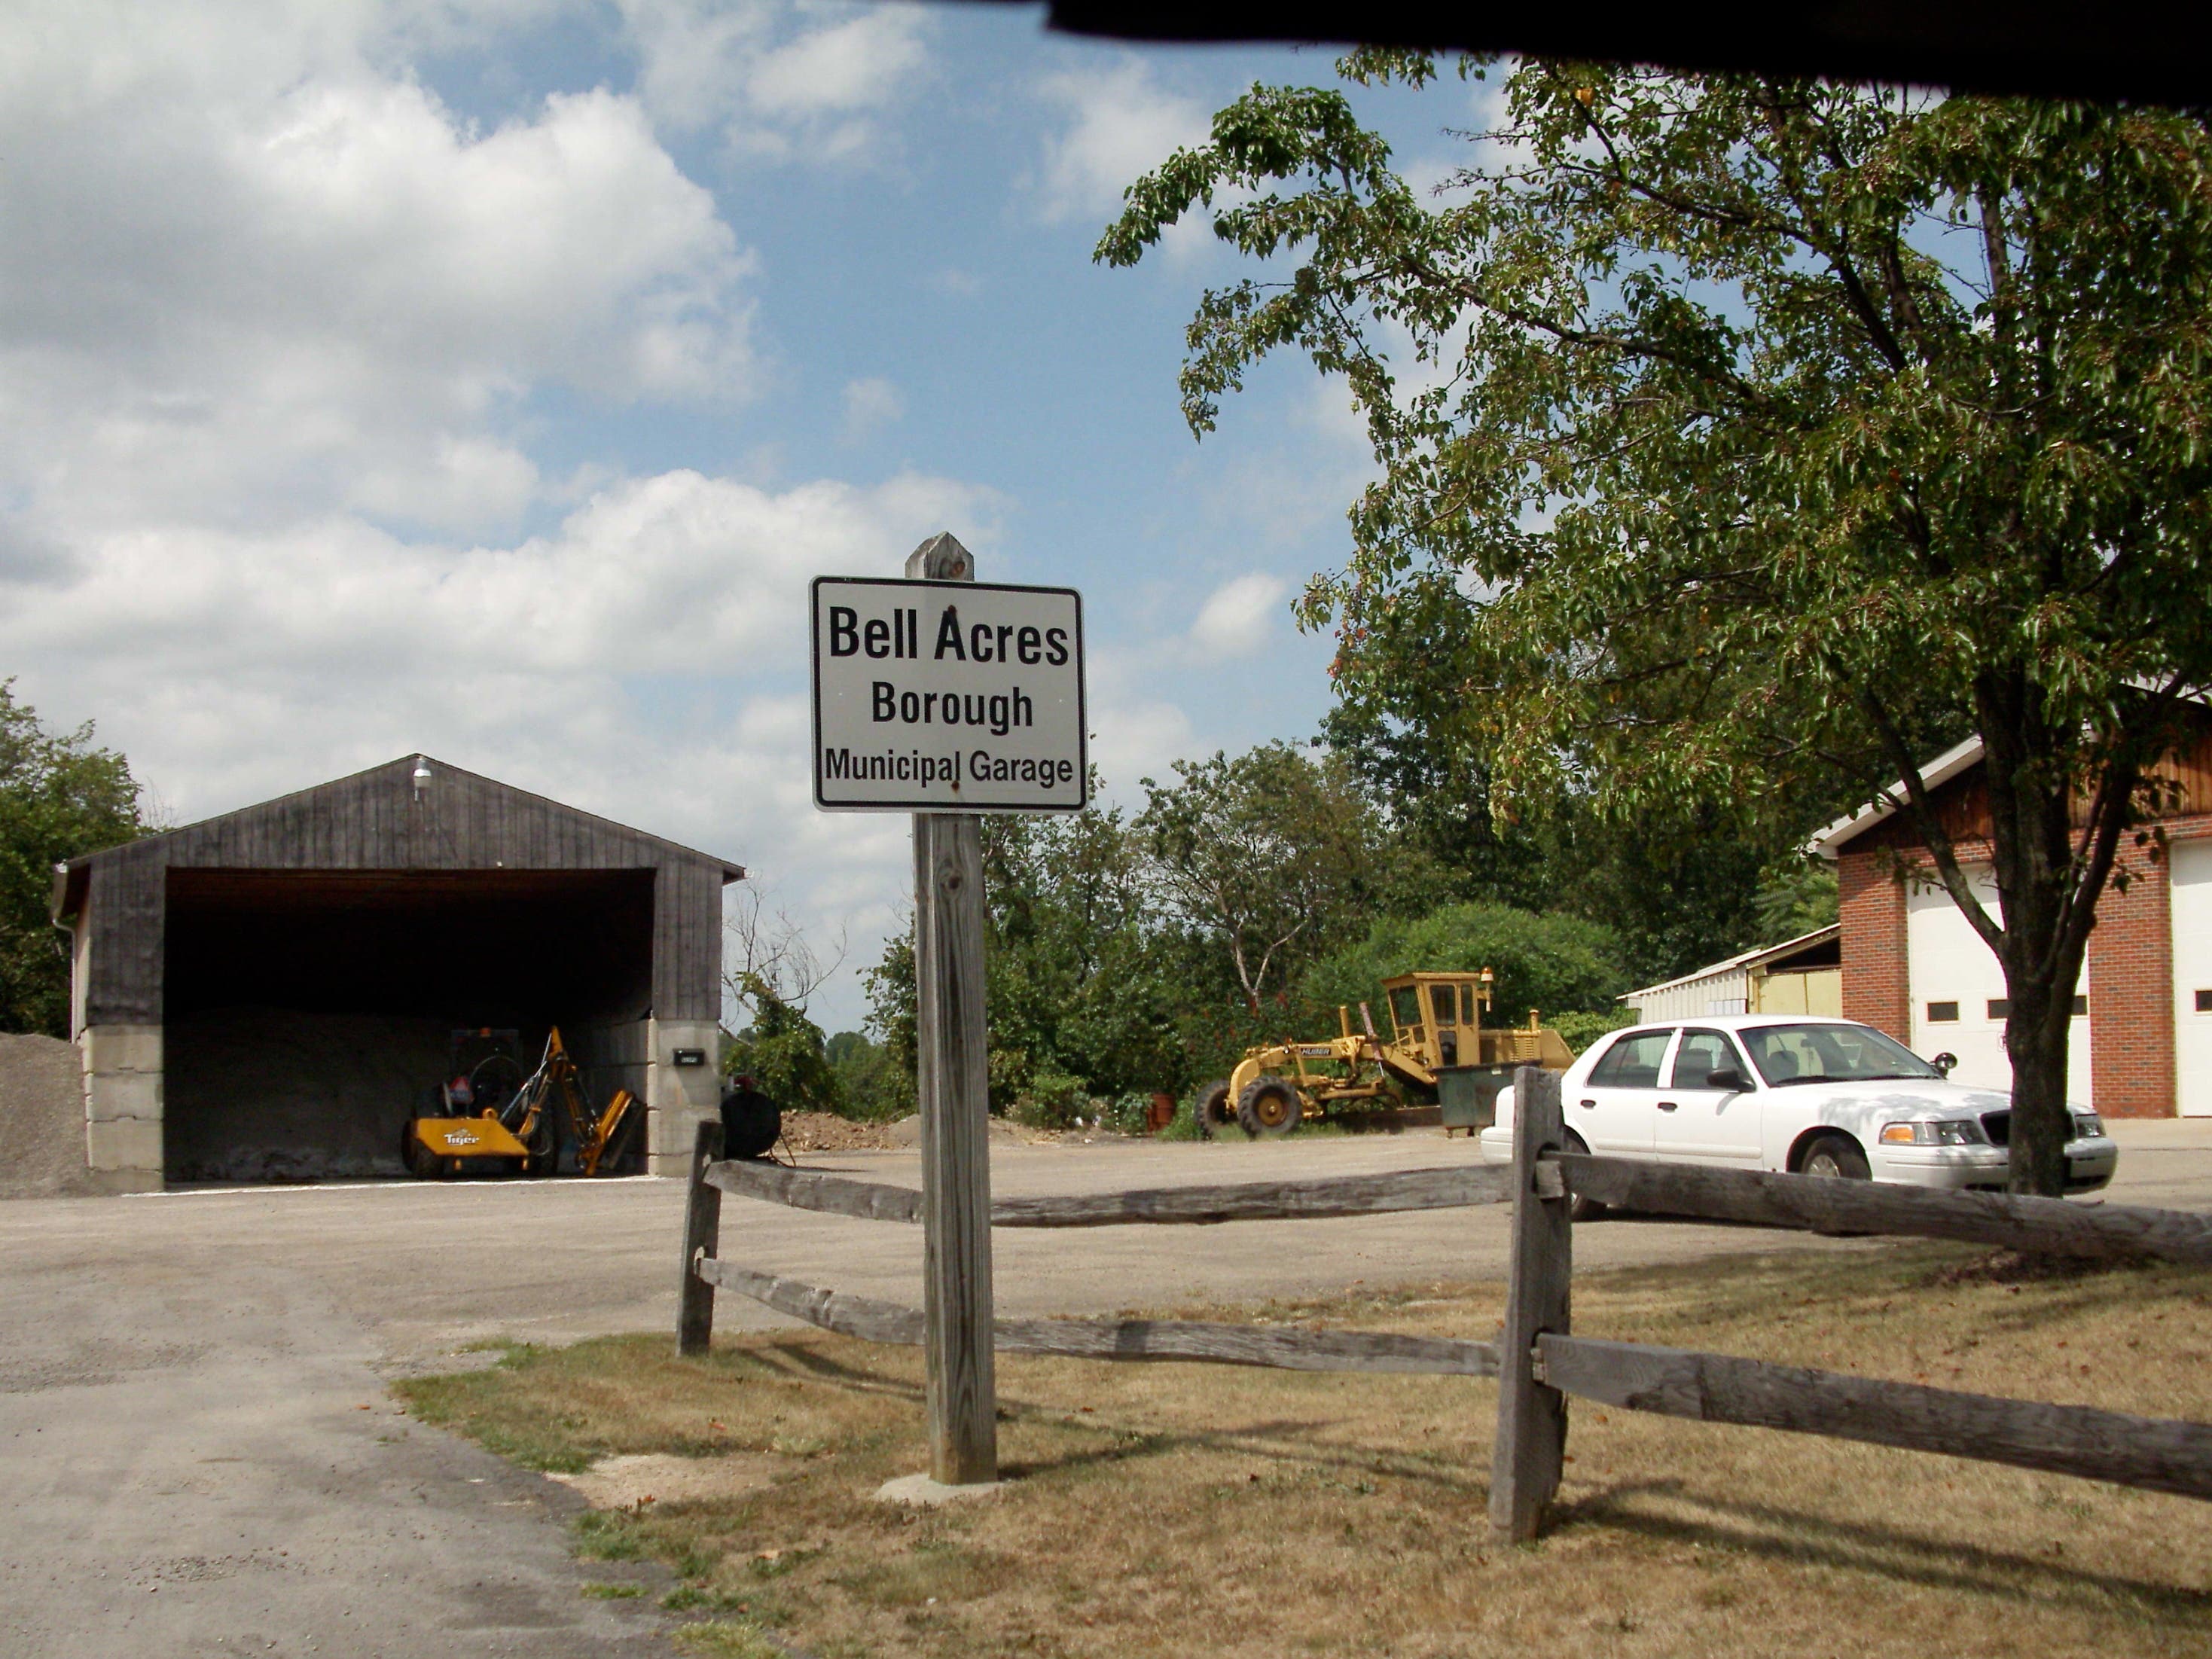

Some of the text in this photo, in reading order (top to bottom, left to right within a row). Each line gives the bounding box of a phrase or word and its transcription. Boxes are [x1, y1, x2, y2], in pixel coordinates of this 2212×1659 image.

[829, 606, 1069, 666] Bell Acres
[872, 681, 1033, 736] Borough
[825, 748, 1073, 789] Municipal Garage
[444, 1133, 480, 1145] Tiger
